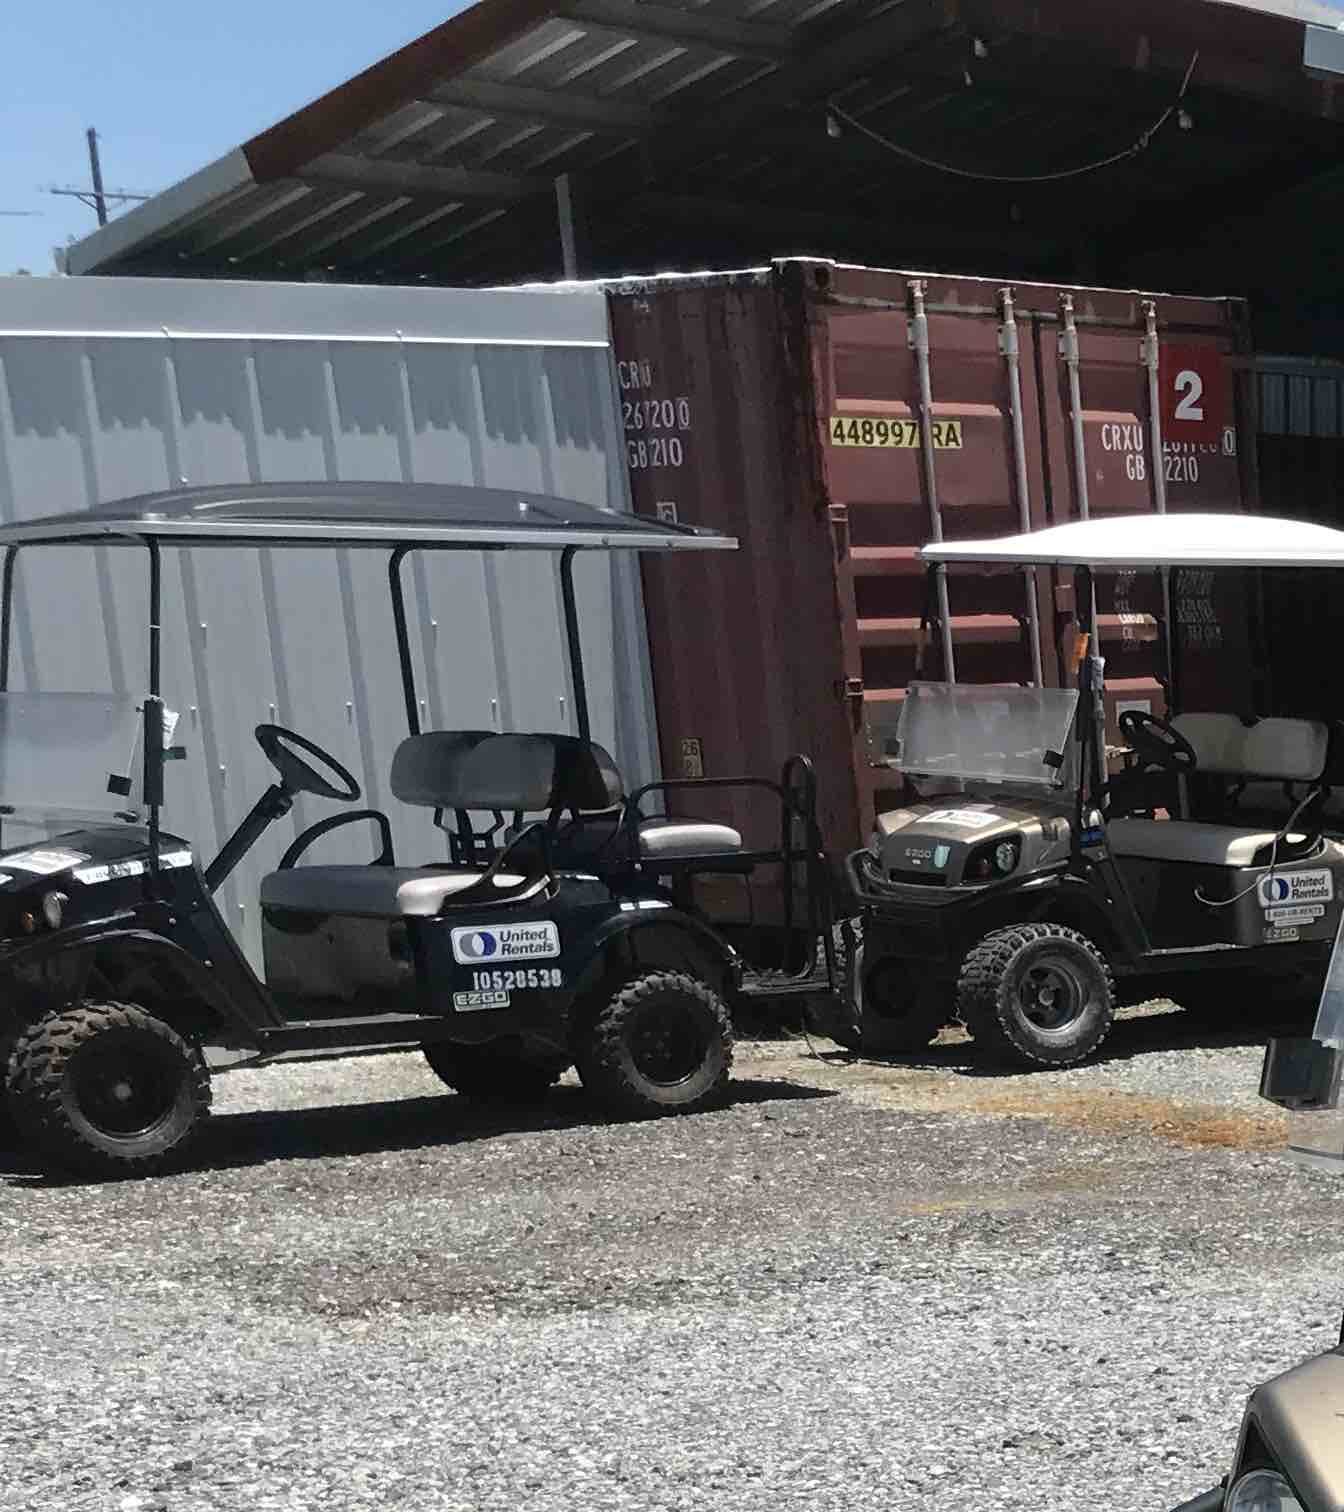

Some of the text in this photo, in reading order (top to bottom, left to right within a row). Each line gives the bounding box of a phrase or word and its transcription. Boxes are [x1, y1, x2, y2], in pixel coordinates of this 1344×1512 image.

[1174, 369, 1204, 421] 2
[832, 418, 918, 446] 448997
[1101, 423, 1144, 451] CRXU
[1126, 453, 1199, 482] GB 2210
[1291, 875, 1326, 888] United
[500, 927, 548, 943] United
[501, 941, 554, 956] Rentals
[455, 991, 508, 1006] EZGO
